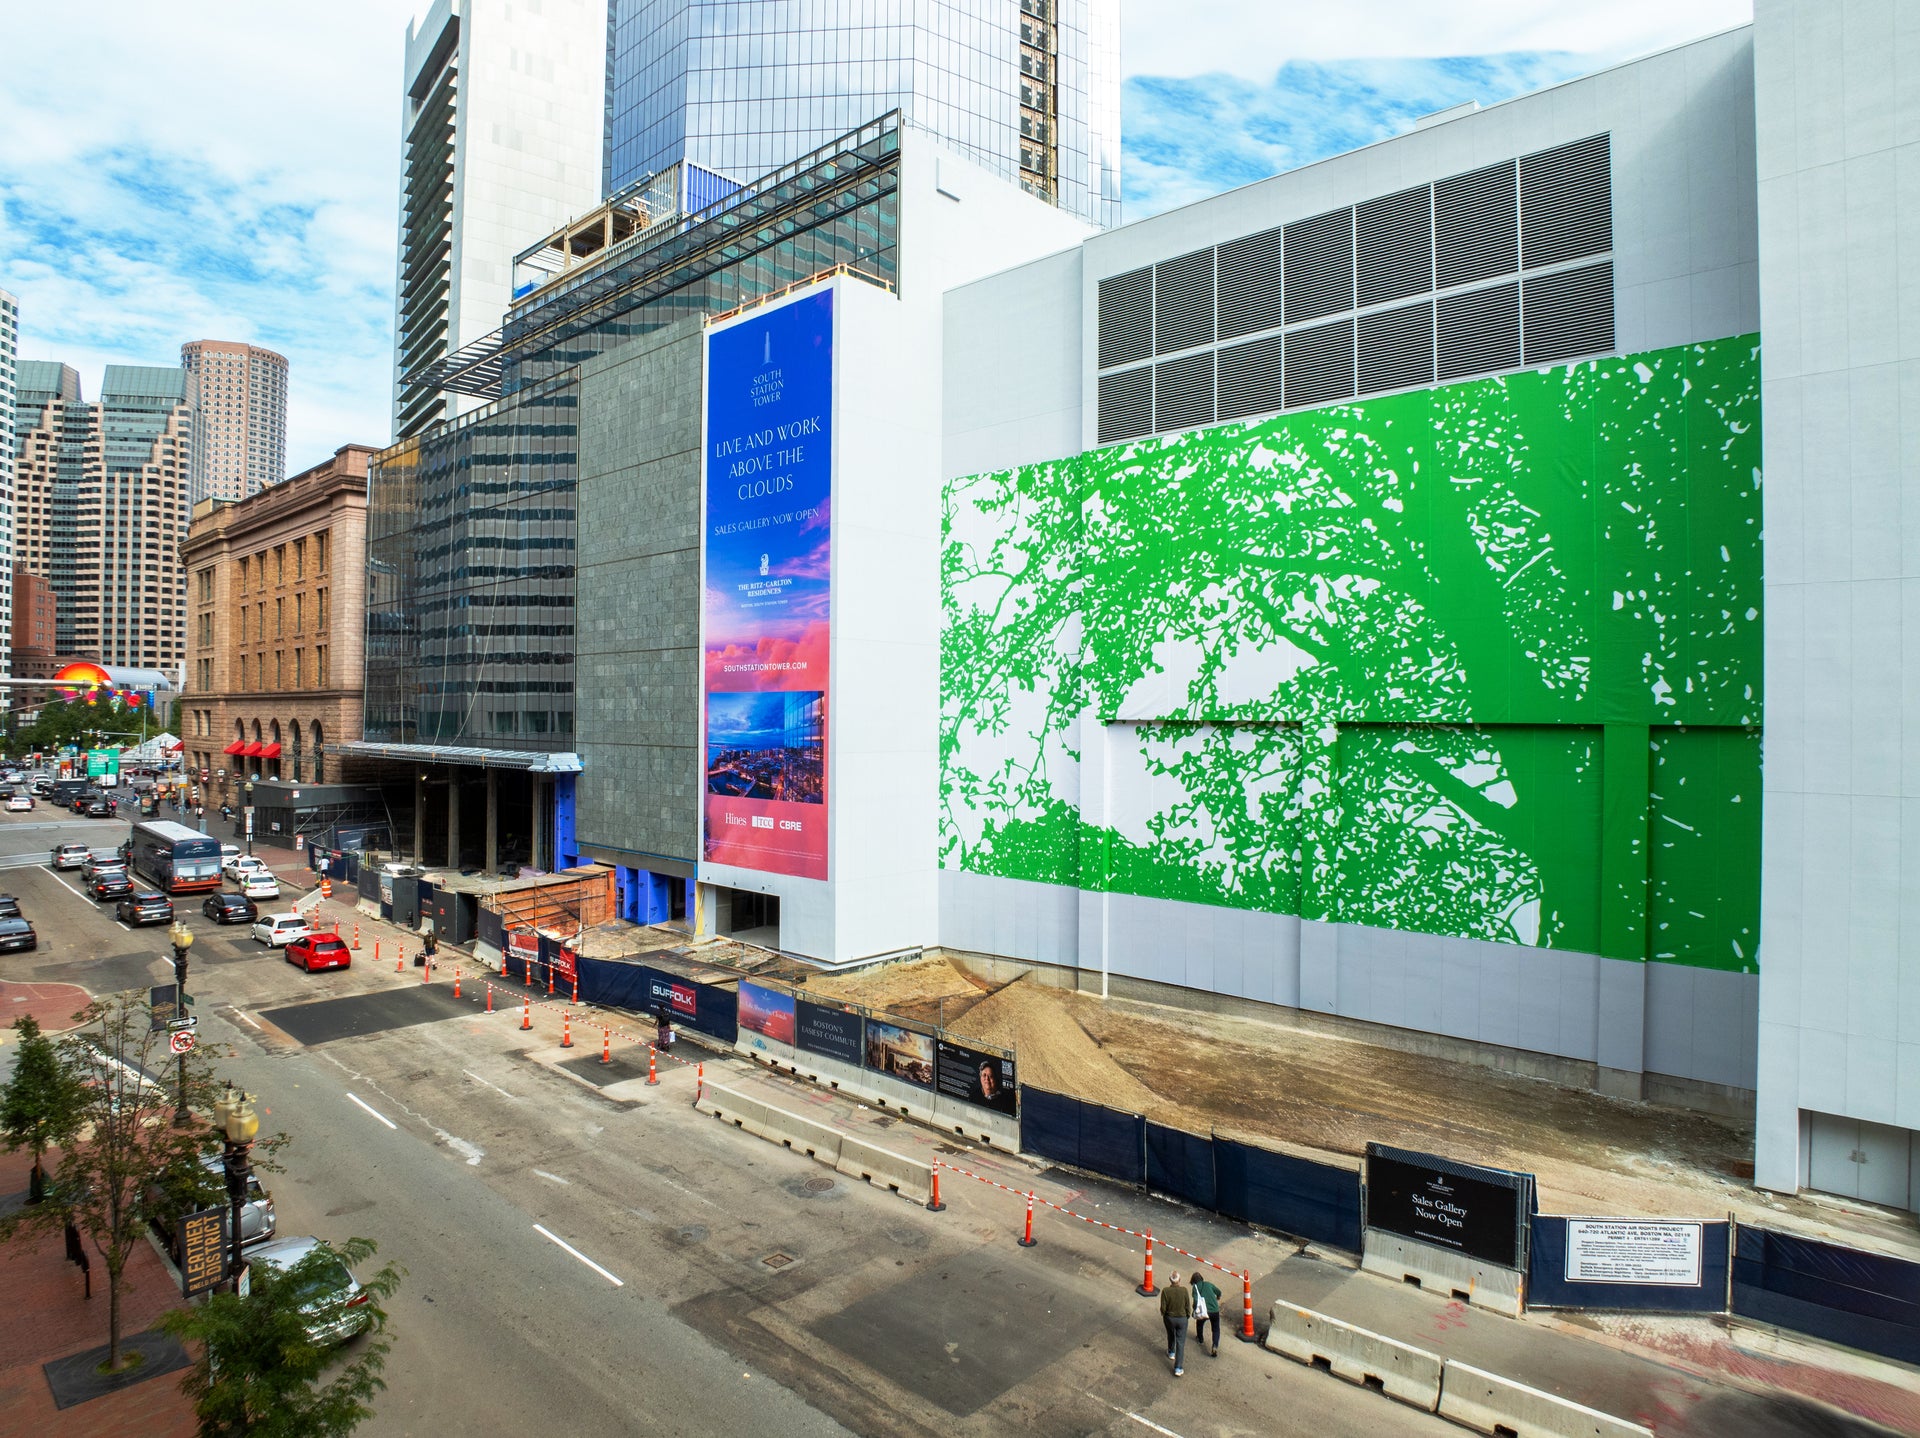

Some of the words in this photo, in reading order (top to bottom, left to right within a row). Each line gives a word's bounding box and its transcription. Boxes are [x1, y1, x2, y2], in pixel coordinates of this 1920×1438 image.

[753, 368, 782, 386] SOUTH
[750, 378, 784, 398] STATION
[753, 392, 781, 408] TOWER
[716, 437, 742, 458] LIVE
[745, 430, 774, 451] AND
[777, 416, 821, 441] WORK
[729, 454, 774, 478] ABOVE
[777, 446, 804, 467] THE
[738, 474, 794, 500] CLOUDS
[714, 521, 736, 536] SALES
[738, 516, 771, 532] GALLERY
[772, 512, 794, 526] NOW
[796, 508, 819, 522] OPEN
[748, 587, 782, 597] RESIDENCES
[724, 661, 808, 672] SOUTHSTATIONTOWER.COM
[725, 812, 746, 826] Hines
[758, 818, 773, 827] TCC
[779, 820, 802, 831] CBRE
[652, 985, 692, 1006] SUFFOLK
[802, 1026, 824, 1039] EASIEST
[824, 1032, 857, 1047] COMMUTE
[813, 1020, 843, 1034] BOSTON'S
[1412, 1193, 1433, 1207] Sales
[1435, 1200, 1468, 1218] Gallery
[1416, 1207, 1436, 1220] Now
[1438, 1214, 1463, 1228] Open
[186, 1217, 206, 1283] LEATHER
[203, 1215, 222, 1277] DISTRICT
